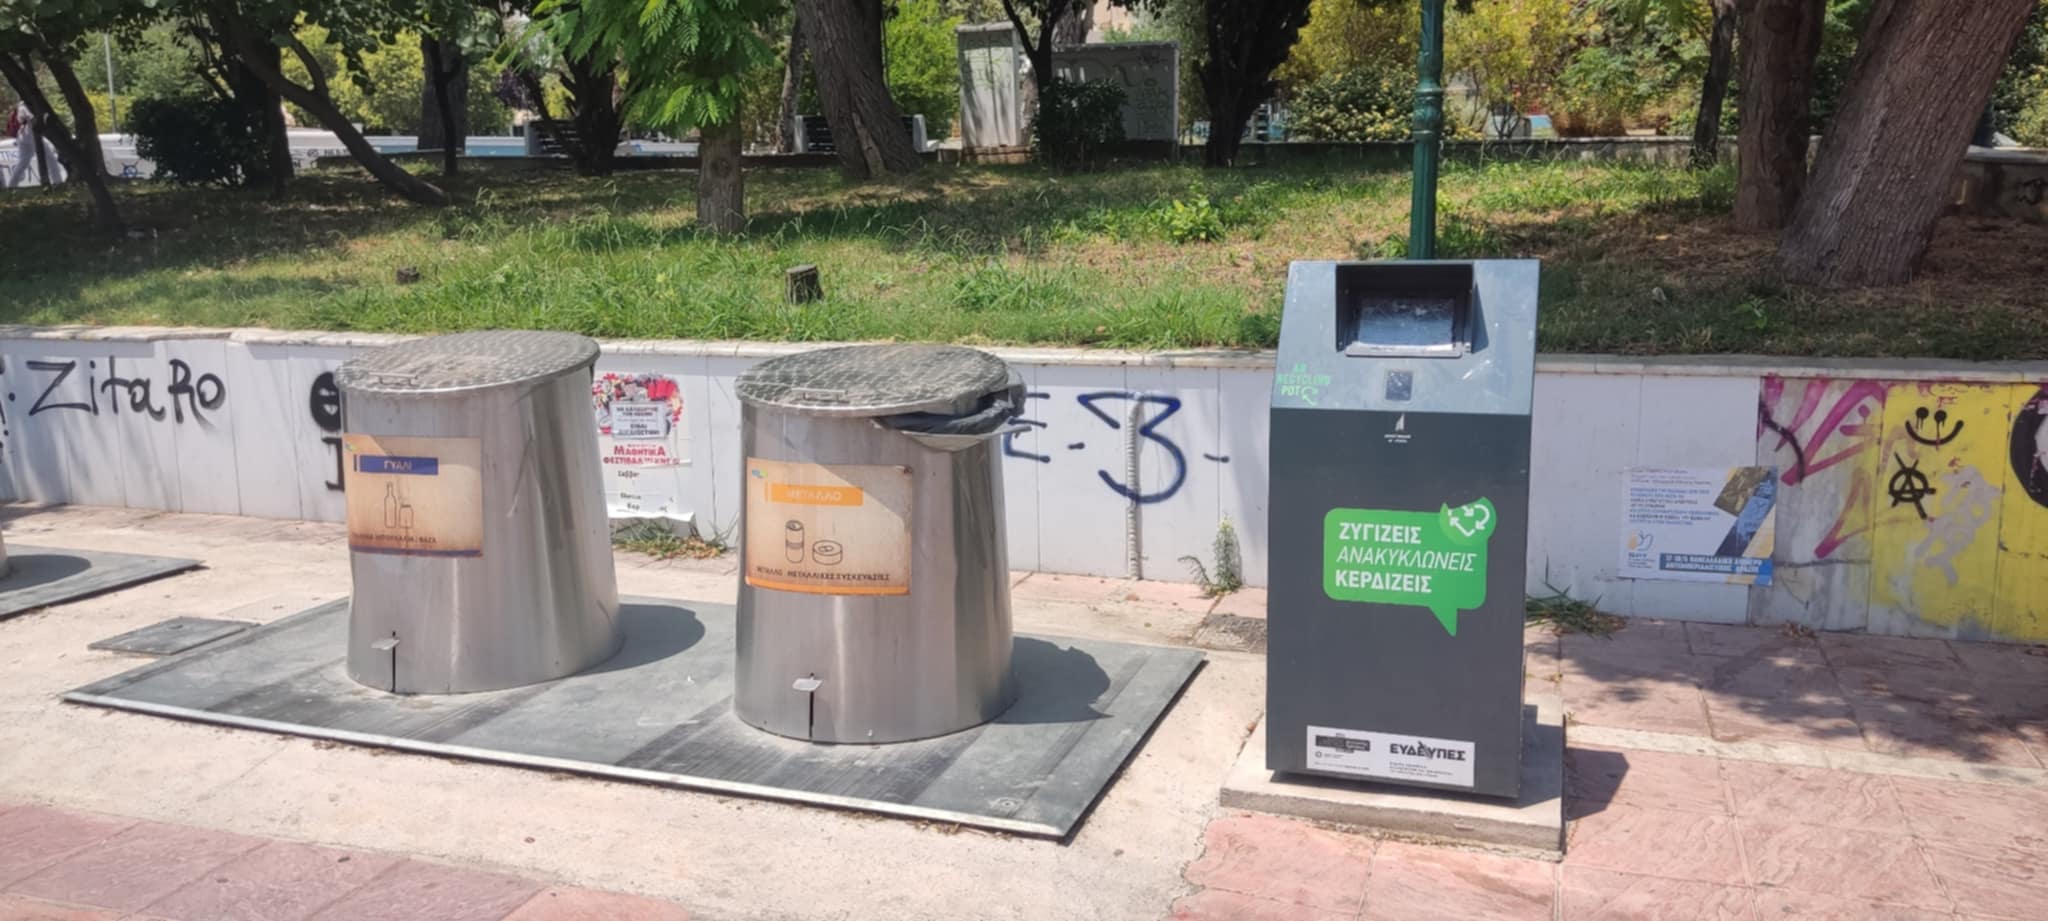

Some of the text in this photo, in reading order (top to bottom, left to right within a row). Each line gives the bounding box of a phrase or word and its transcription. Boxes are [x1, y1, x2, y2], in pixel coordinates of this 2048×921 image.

[1338, 522, 1422, 544] ΖΥΓΙΖΕΙΣ
[1336, 546, 1478, 572] ΑΝΑΚΥΚΛΩΝΕΙΣ
[1335, 569, 1433, 593] ΚΕΡΔΙΖΕΙΣ
